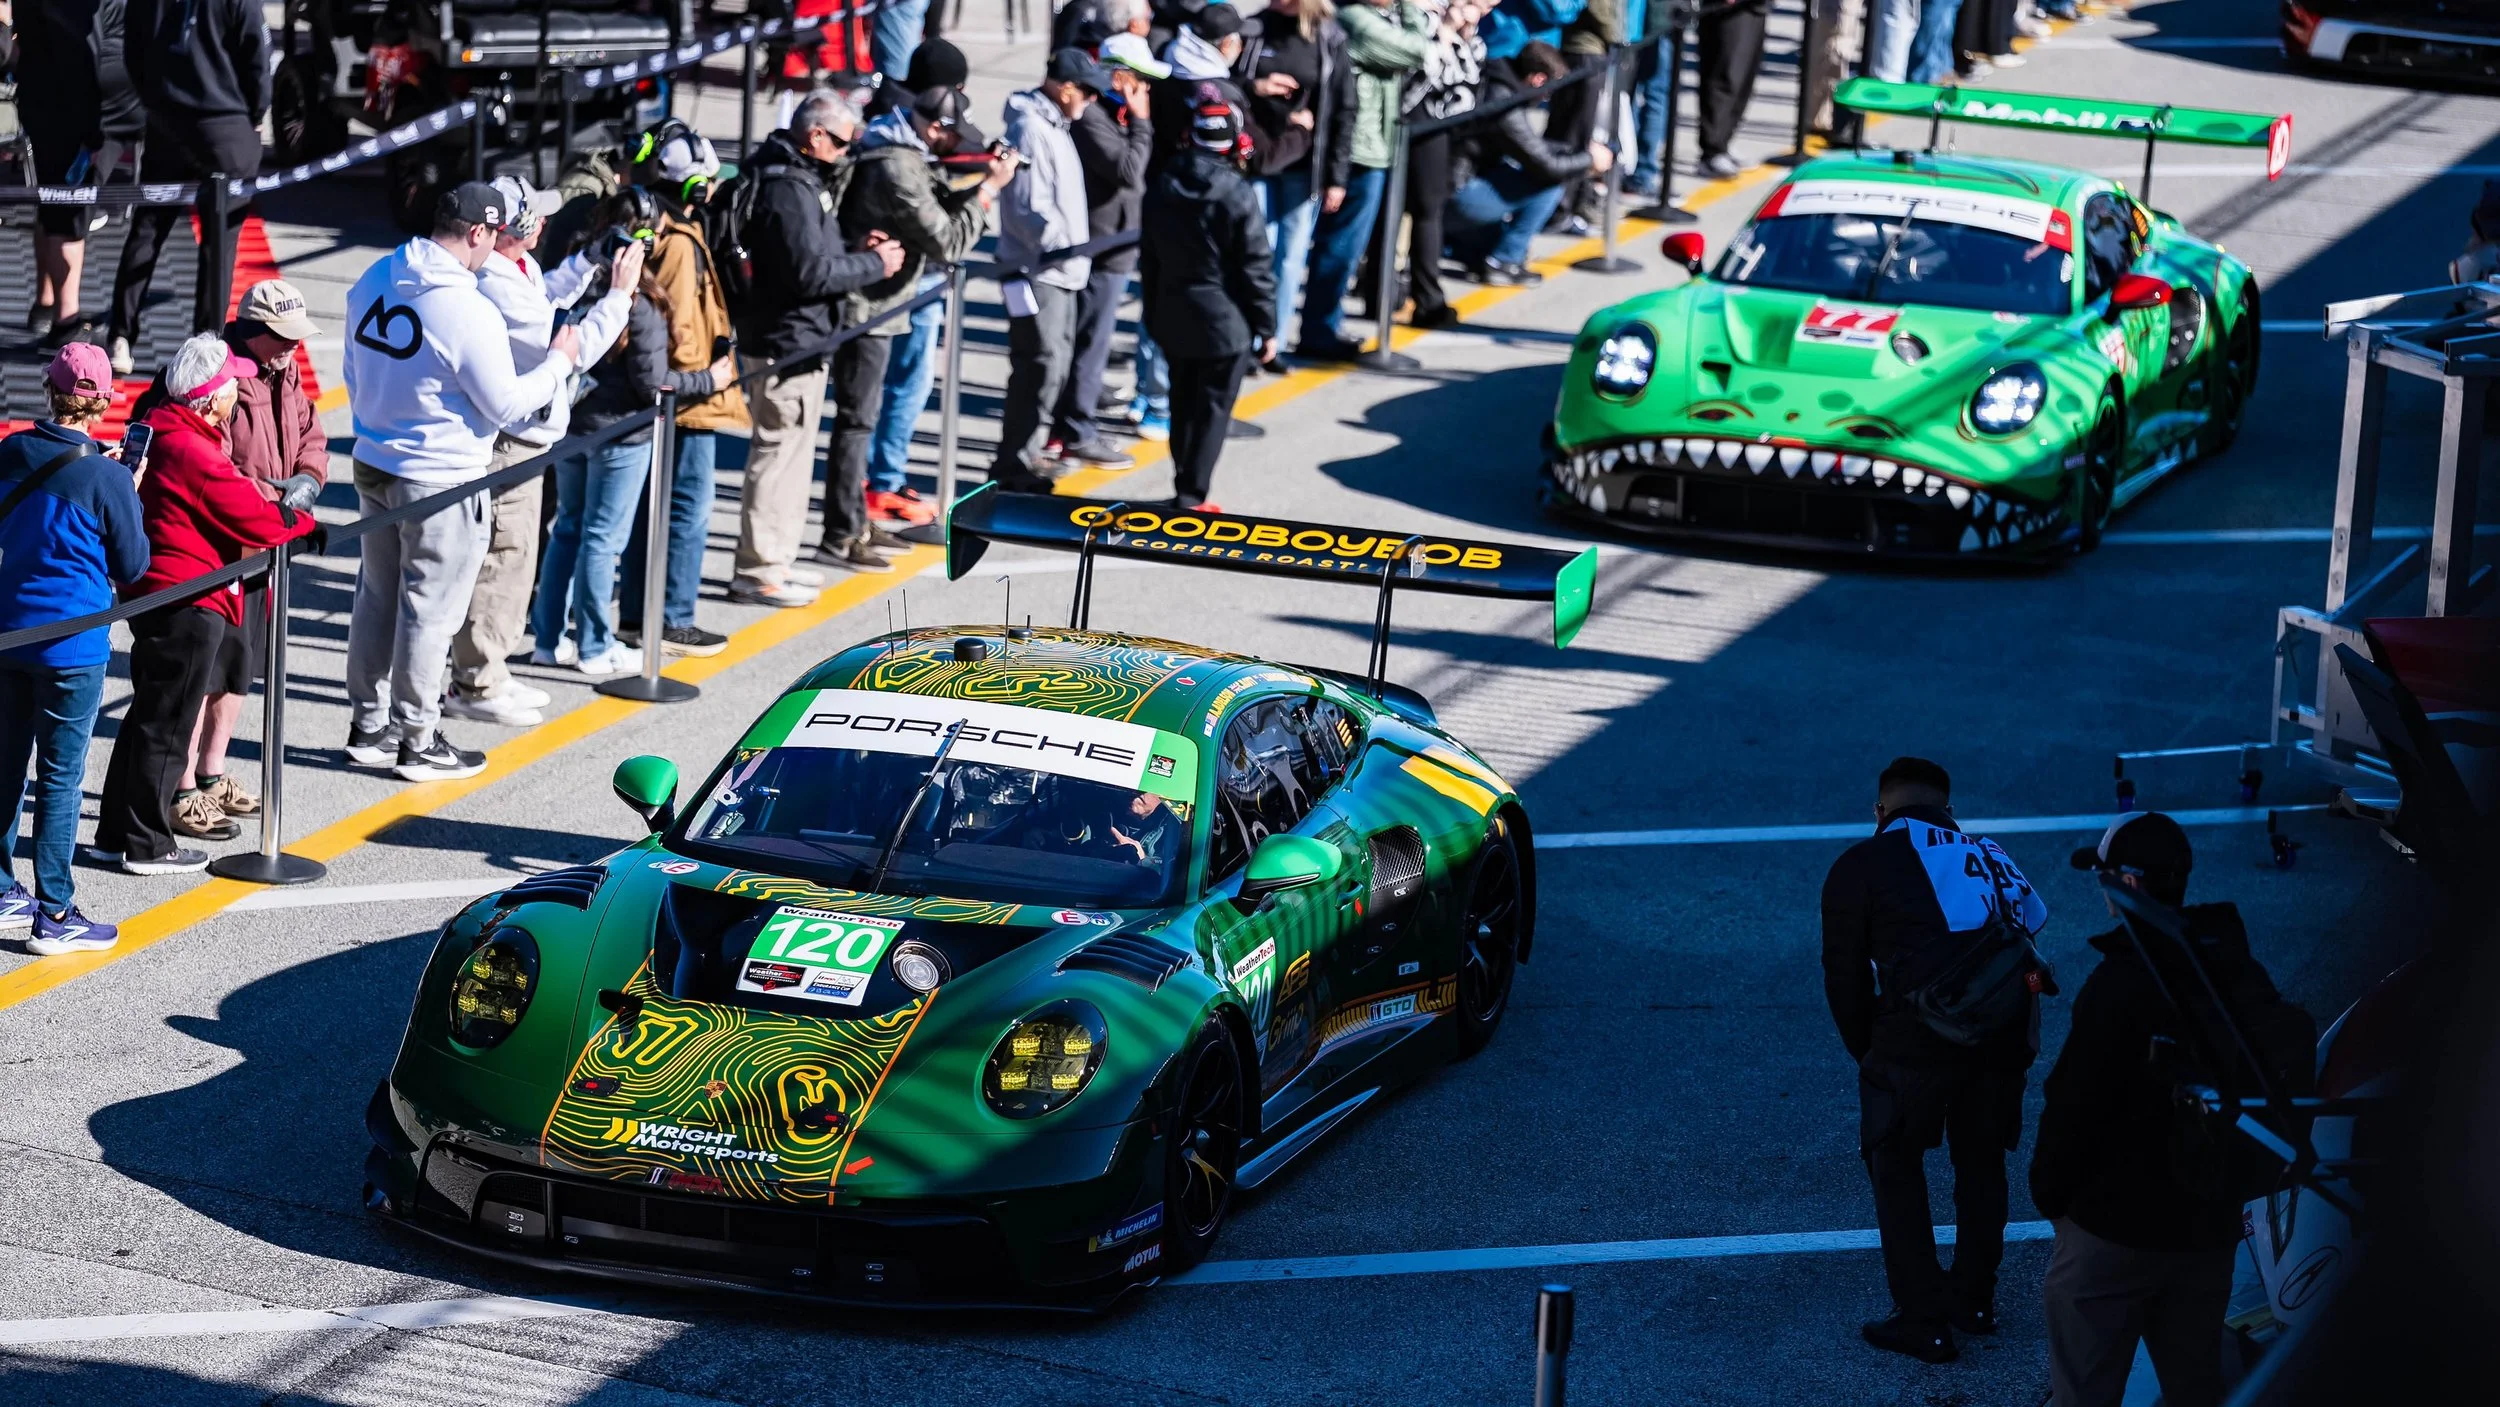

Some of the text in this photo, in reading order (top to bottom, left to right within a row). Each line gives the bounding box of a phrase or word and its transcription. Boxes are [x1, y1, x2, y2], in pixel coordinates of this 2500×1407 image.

[484, 206, 499, 224] 2
[1794, 192, 2041, 225] PORSCHE
[1131, 538, 1243, 560] COFFEE
[805, 713, 1136, 767] PORSCHE
[783, 907, 902, 928] WeatherTech
[768, 918, 886, 968] 120
[1236, 943, 1275, 977] WeatherTech
[630, 1135, 779, 1164] Motorsports
[1115, 1213, 1158, 1239] MICHELIN
[1123, 1243, 1161, 1273] MOTUL
